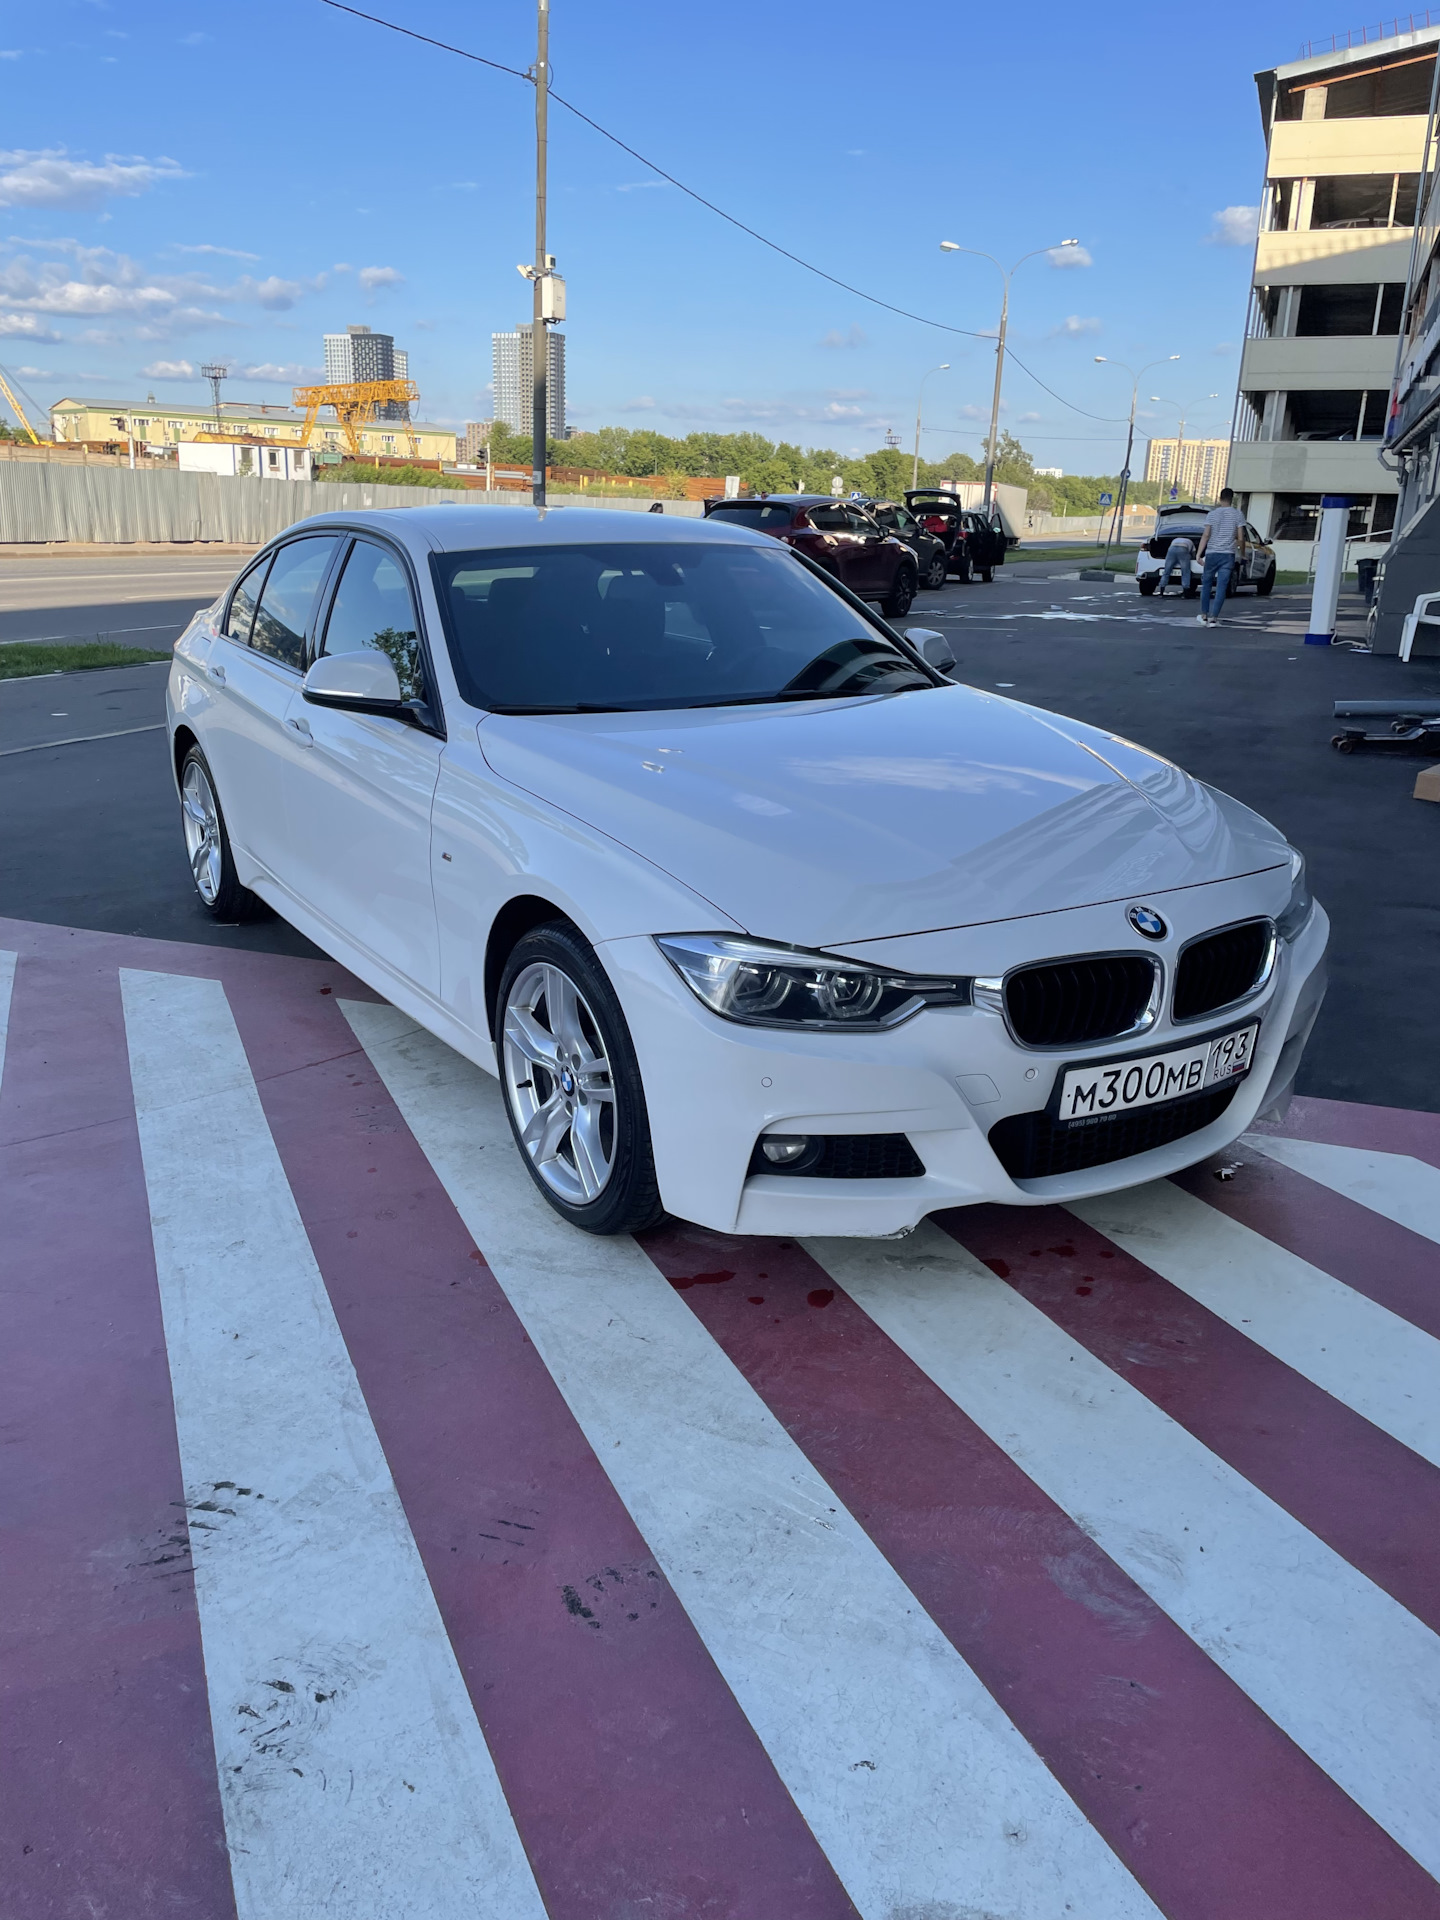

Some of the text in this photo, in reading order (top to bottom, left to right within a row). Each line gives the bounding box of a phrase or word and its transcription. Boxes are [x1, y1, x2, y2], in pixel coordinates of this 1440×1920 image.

[1071, 1060, 1204, 1115] М300МВ
[1211, 1031, 1250, 1069] 193
[1213, 1064, 1232, 1080] RUS
